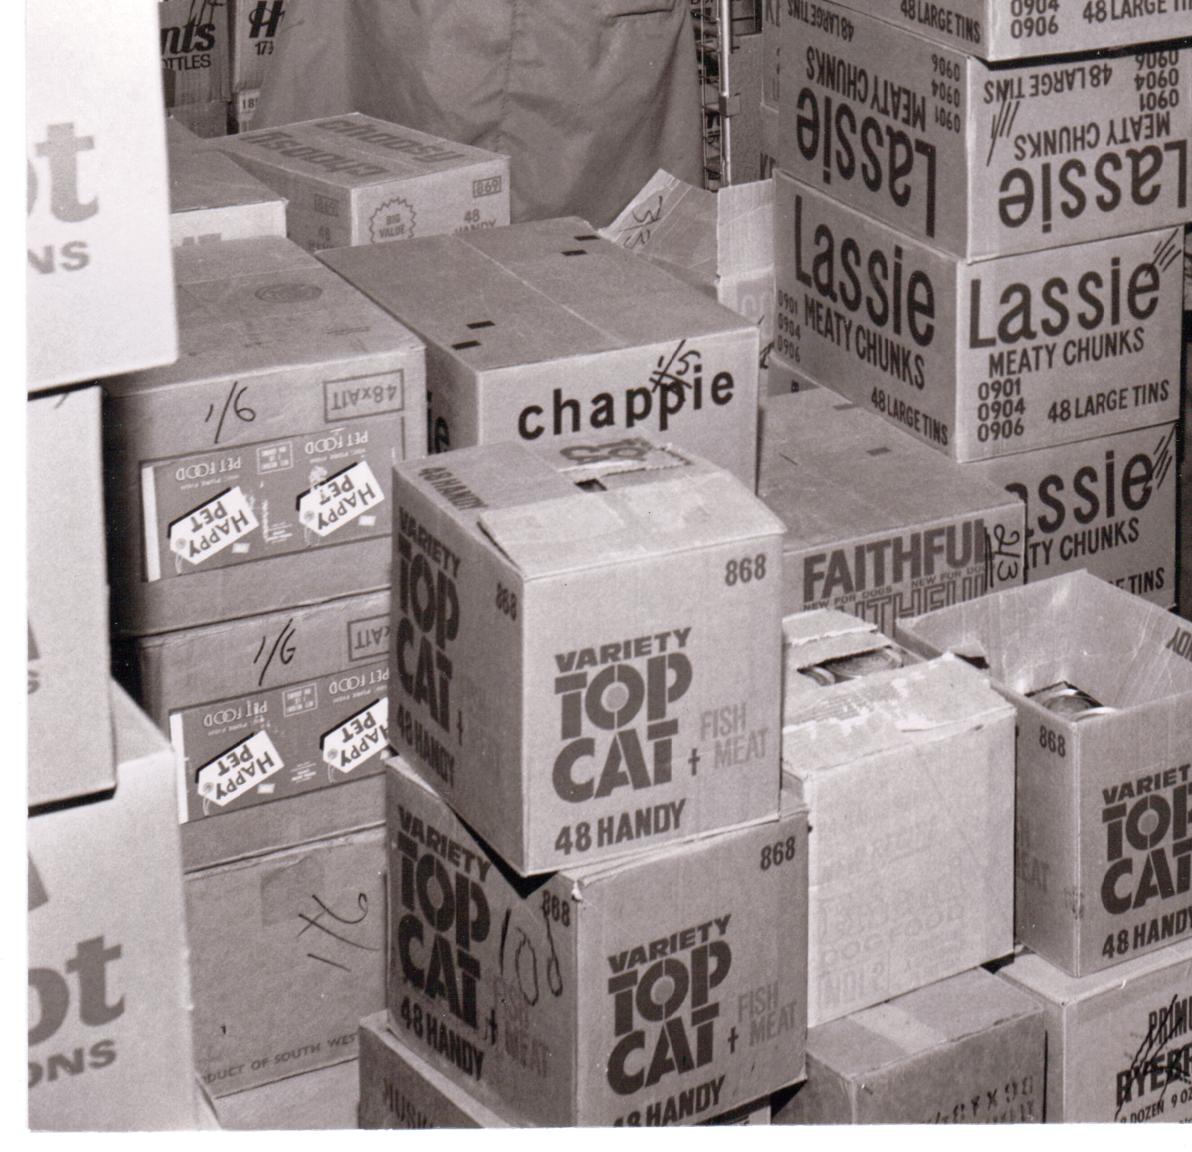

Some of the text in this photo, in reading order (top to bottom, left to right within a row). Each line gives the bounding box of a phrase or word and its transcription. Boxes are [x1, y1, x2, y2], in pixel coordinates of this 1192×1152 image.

[918, 2, 953, 35] LARGE
[955, 12, 981, 45] TINS
[1010, 17, 1059, 39] 0906
[1083, 0, 1107, 23] 48
[1135, 49, 1179, 70] 0906
[1135, 67, 1179, 91] 0904
[1029, 66, 1085, 97] LARGE
[1139, 89, 1180, 112] 0901
[870, 74, 926, 132] MEATY
[1014, 111, 1171, 162] MEATY CHUNKS
[796, 86, 936, 239] Lassie
[477, 179, 499, 194] 869
[998, 139, 1188, 234] Lassie
[379, 227, 406, 239] VALUE
[464, 209, 481, 222] 48
[794, 195, 936, 348] Lassie
[969, 256, 1161, 349] Lassie
[856, 323, 925, 391] CHUNKS
[988, 326, 1146, 378] MEATY CHUNKS
[518, 358, 736, 441] chappie
[978, 381, 1022, 401] 0901
[978, 400, 1027, 422] 0904
[1047, 379, 1170, 424] 48 LARGE TINS
[305, 435, 343, 455] FOOD
[977, 421, 1025, 443] 0906
[175, 461, 215, 481] FOOD
[191, 500, 229, 533] PET
[317, 482, 377, 531] HAPPY
[189, 509, 249, 558] HAPPY
[1059, 517, 1140, 561] CHUNKS
[725, 553, 767, 586] 868
[912, 569, 962, 587] NEW FOR
[1132, 566, 1165, 595] TINS
[862, 585, 892, 599] DOGS
[554, 627, 692, 673] VARIETY
[328, 675, 365, 695] FOOD
[554, 652, 693, 741] TOP
[203, 706, 242, 728] FOOD
[700, 702, 747, 742] FISH
[216, 744, 255, 777] PET
[552, 719, 679, 804] CAT
[713, 728, 770, 770] MEAT
[1039, 725, 1066, 757] 868
[215, 751, 276, 801] HAPPY
[597, 798, 686, 848] HANDY
[398, 805, 492, 884] VARIETY
[759, 836, 797, 871] 868
[399, 833, 491, 956] TOP
[607, 913, 732, 973] VARIETY
[400, 914, 482, 1030] CAT
[607, 941, 732, 1037] TOP
[250, 1042, 322, 1075] OF SOUTH
[426, 1010, 485, 1083] HANDY
[606, 1001, 720, 1097] CAT
